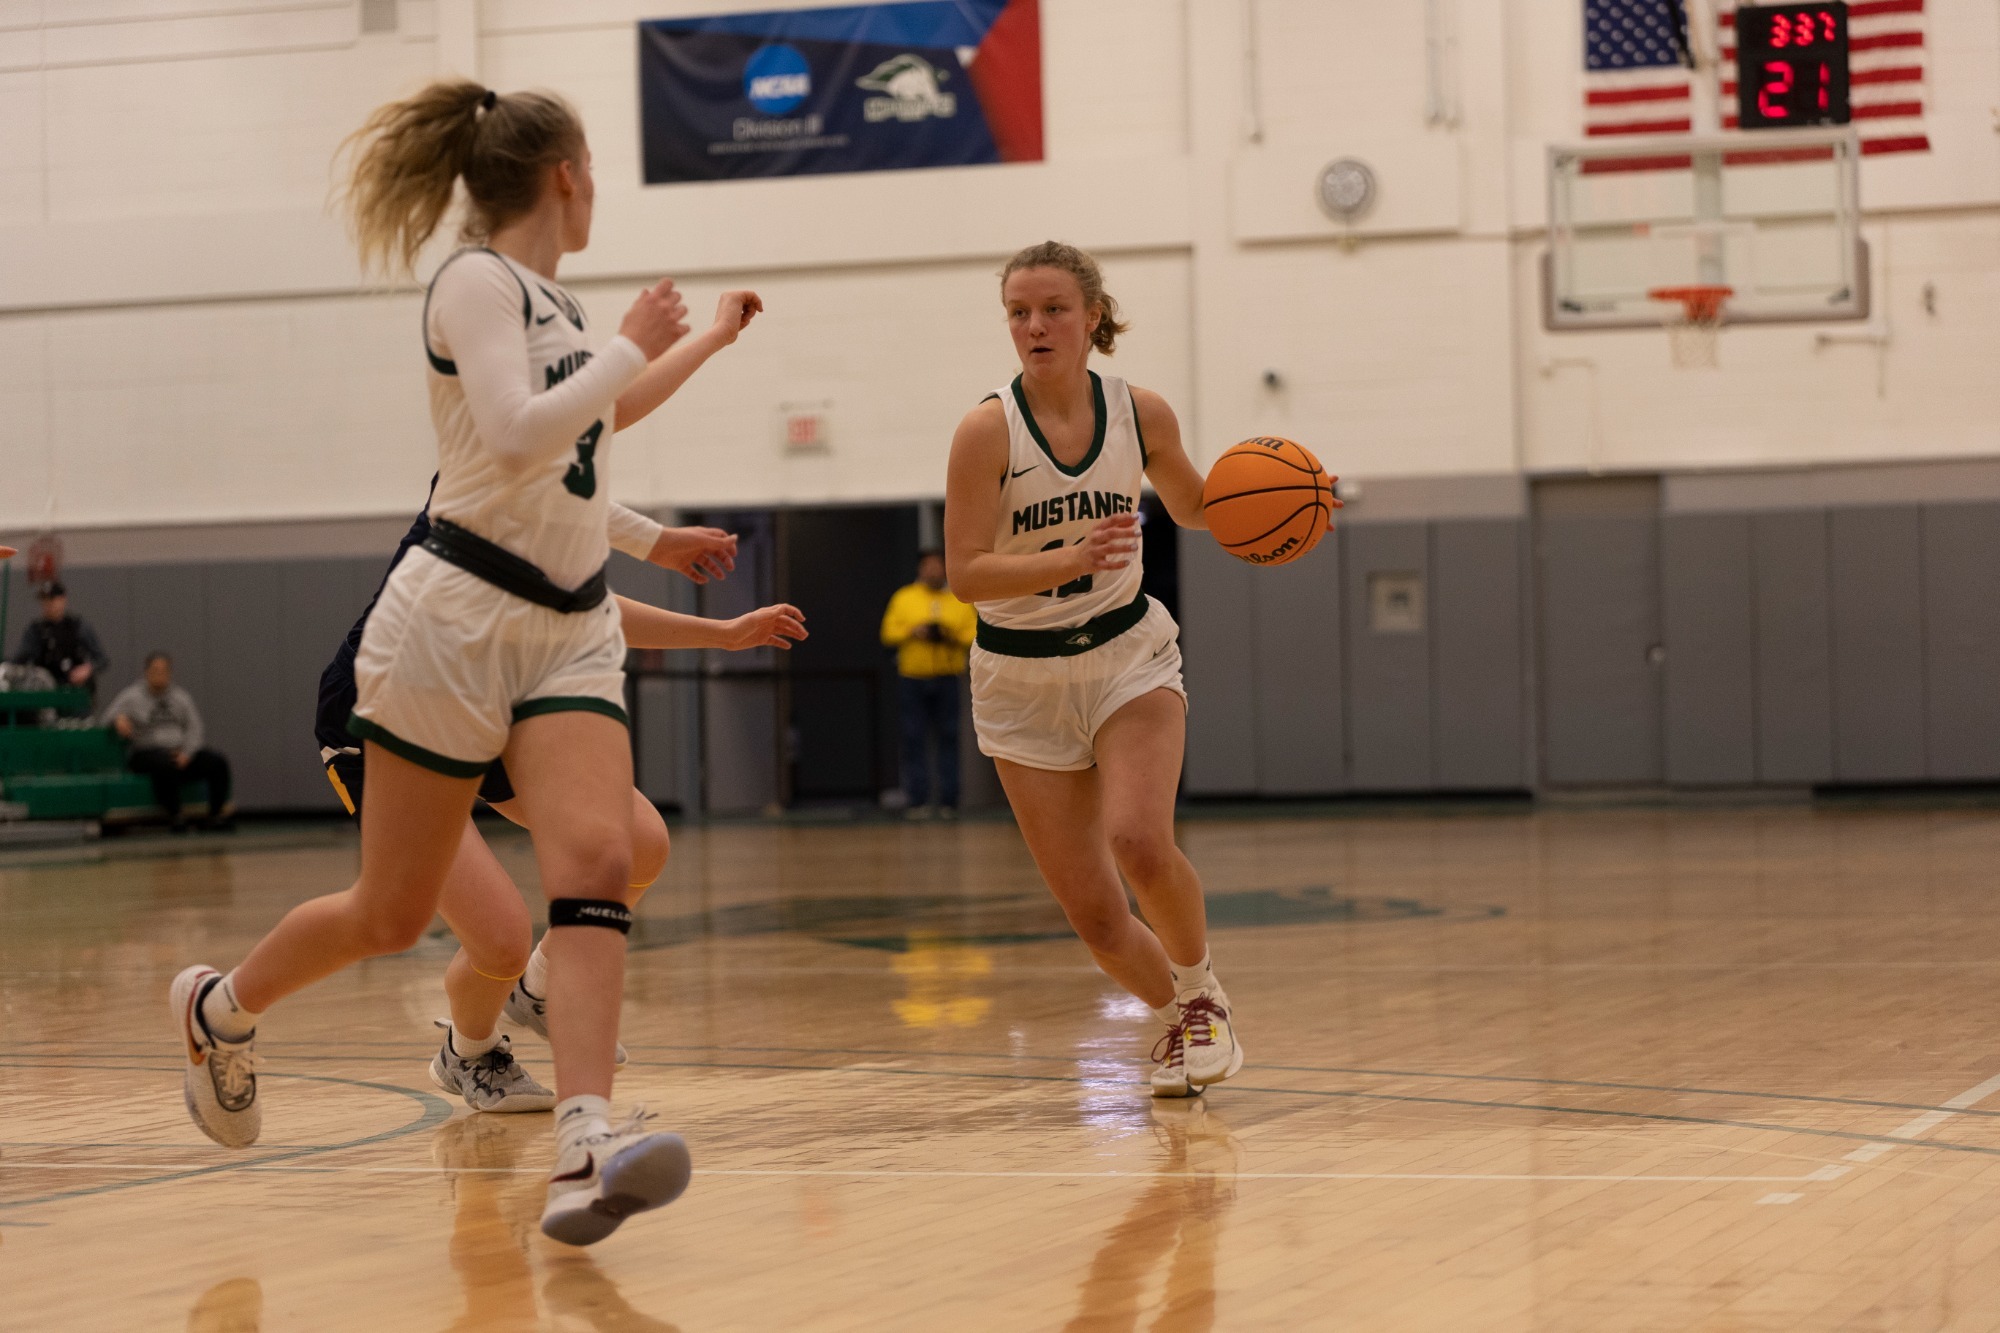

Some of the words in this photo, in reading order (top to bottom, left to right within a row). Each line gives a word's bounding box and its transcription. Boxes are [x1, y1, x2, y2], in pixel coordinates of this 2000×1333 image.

[1757, 60, 1831, 118] 21
[1012, 490, 1133, 535] MUSTANGS
[1241, 536, 1300, 564] ilson
[579, 905, 632, 922] MUELLE
